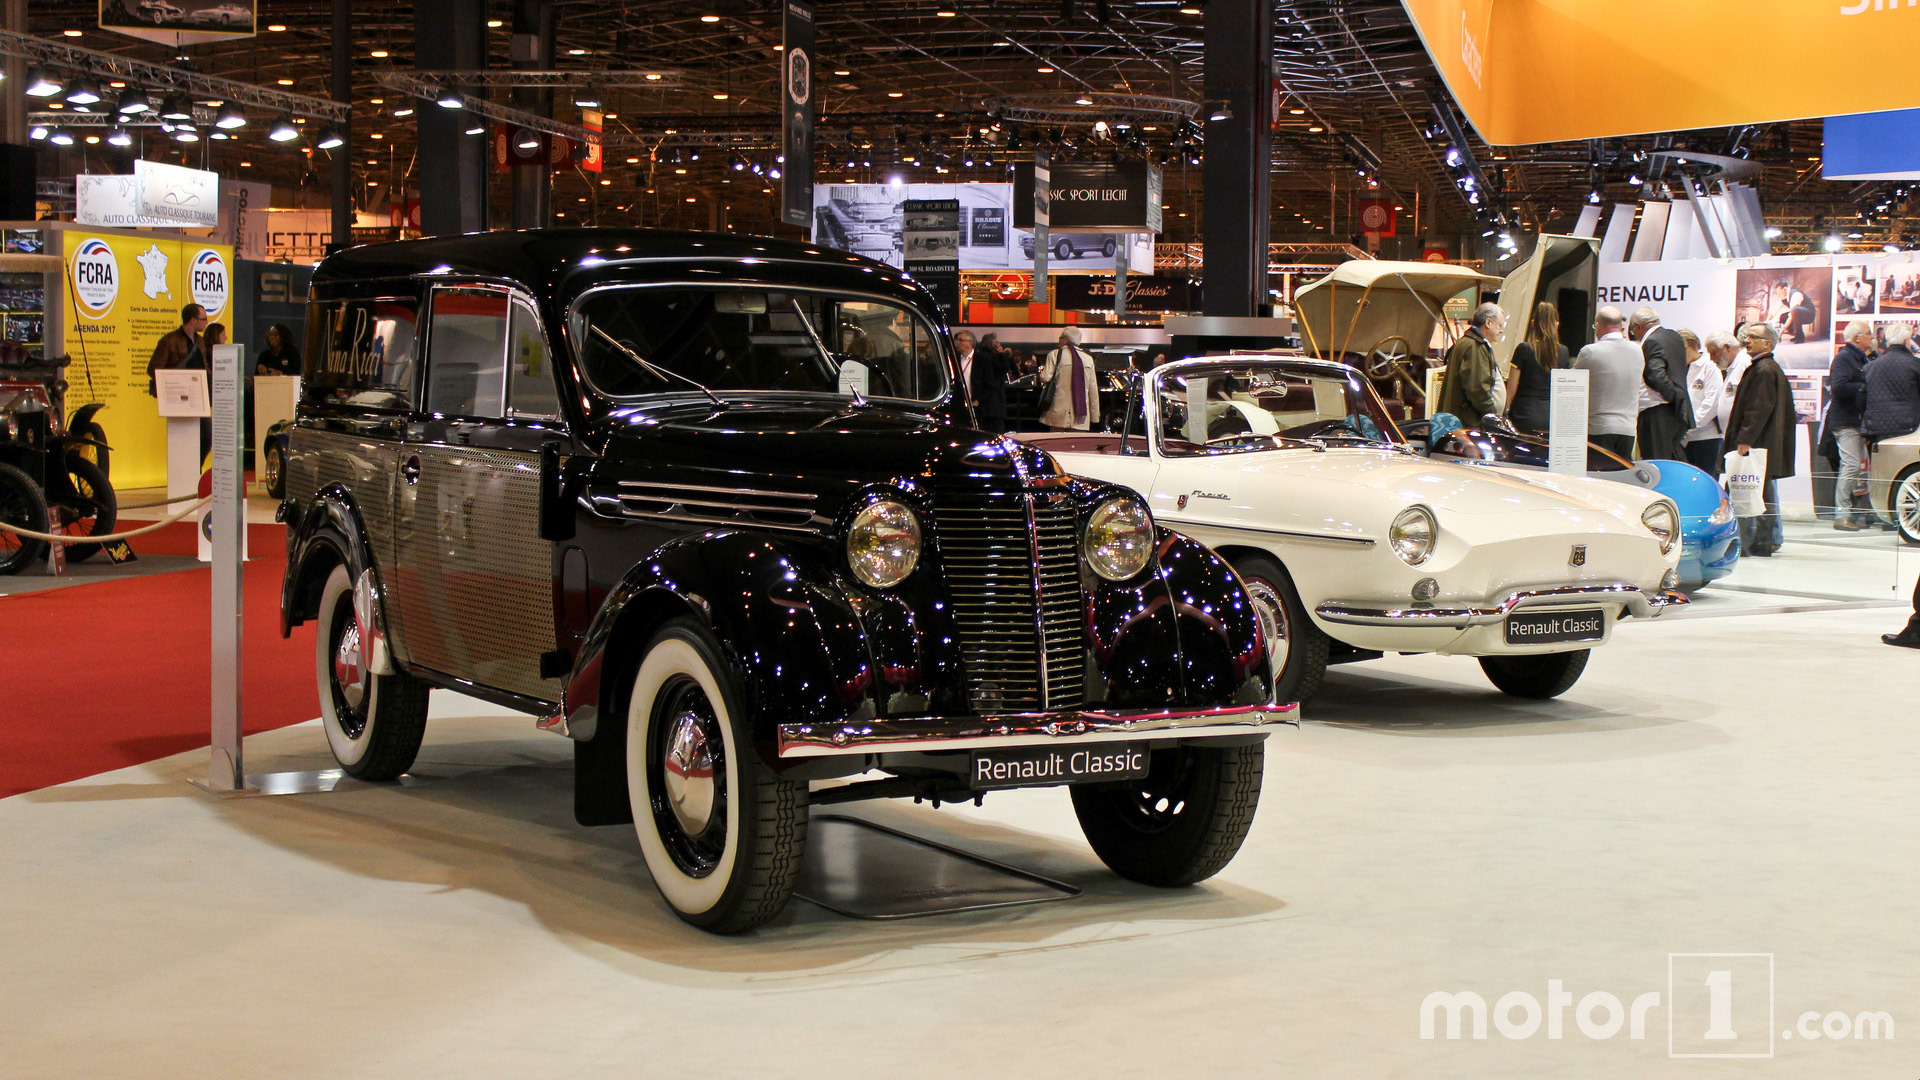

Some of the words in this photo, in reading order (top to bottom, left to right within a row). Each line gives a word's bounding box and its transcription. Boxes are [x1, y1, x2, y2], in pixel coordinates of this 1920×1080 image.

[1069, 189, 1099, 201] SPORT
[1101, 189, 1128, 201] LEICHT
[103, 214, 125, 224] AUTO
[154, 206, 167, 216] AUTO
[168, 207, 194, 219] CLASSIQUE
[193, 211, 216, 223] TOURAINE
[78, 261, 113, 285] FCRA
[194, 270, 224, 292] FCRA
[1598, 284, 1689, 302] RENAULT
[73, 324, 99, 333] AGENDA
[101, 325, 116, 334] 2017
[1510, 619, 1560, 636] Renault
[1562, 617, 1599, 633] Classic
[976, 753, 1064, 781] Renault
[1070, 749, 1142, 774] Classic
